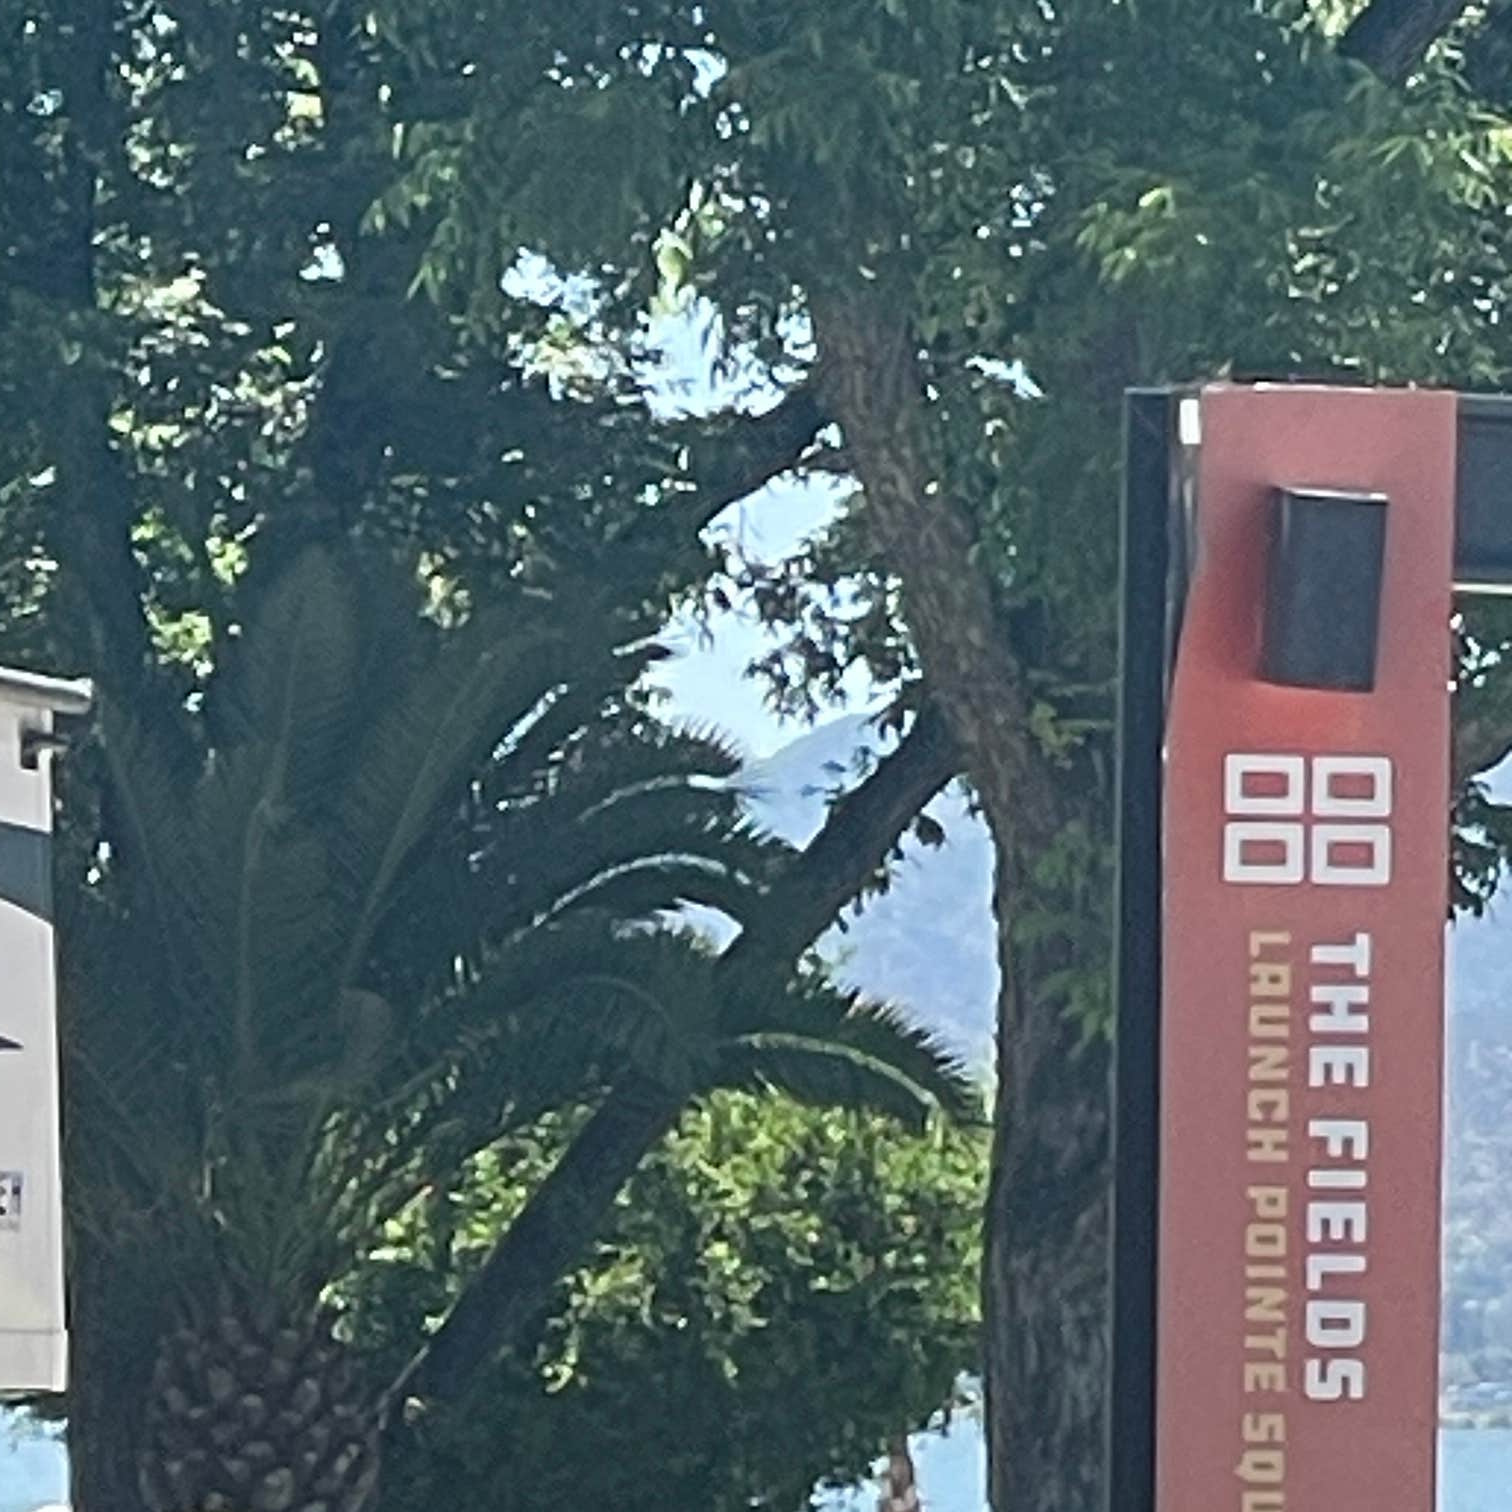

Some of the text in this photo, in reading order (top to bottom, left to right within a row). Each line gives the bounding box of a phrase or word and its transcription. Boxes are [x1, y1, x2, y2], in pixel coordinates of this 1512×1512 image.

[1246, 930, 1292, 1162] LAUNCH
[1303, 931, 1373, 1401] THE FIELDS
[1243, 1186, 1289, 1393] POINTE
